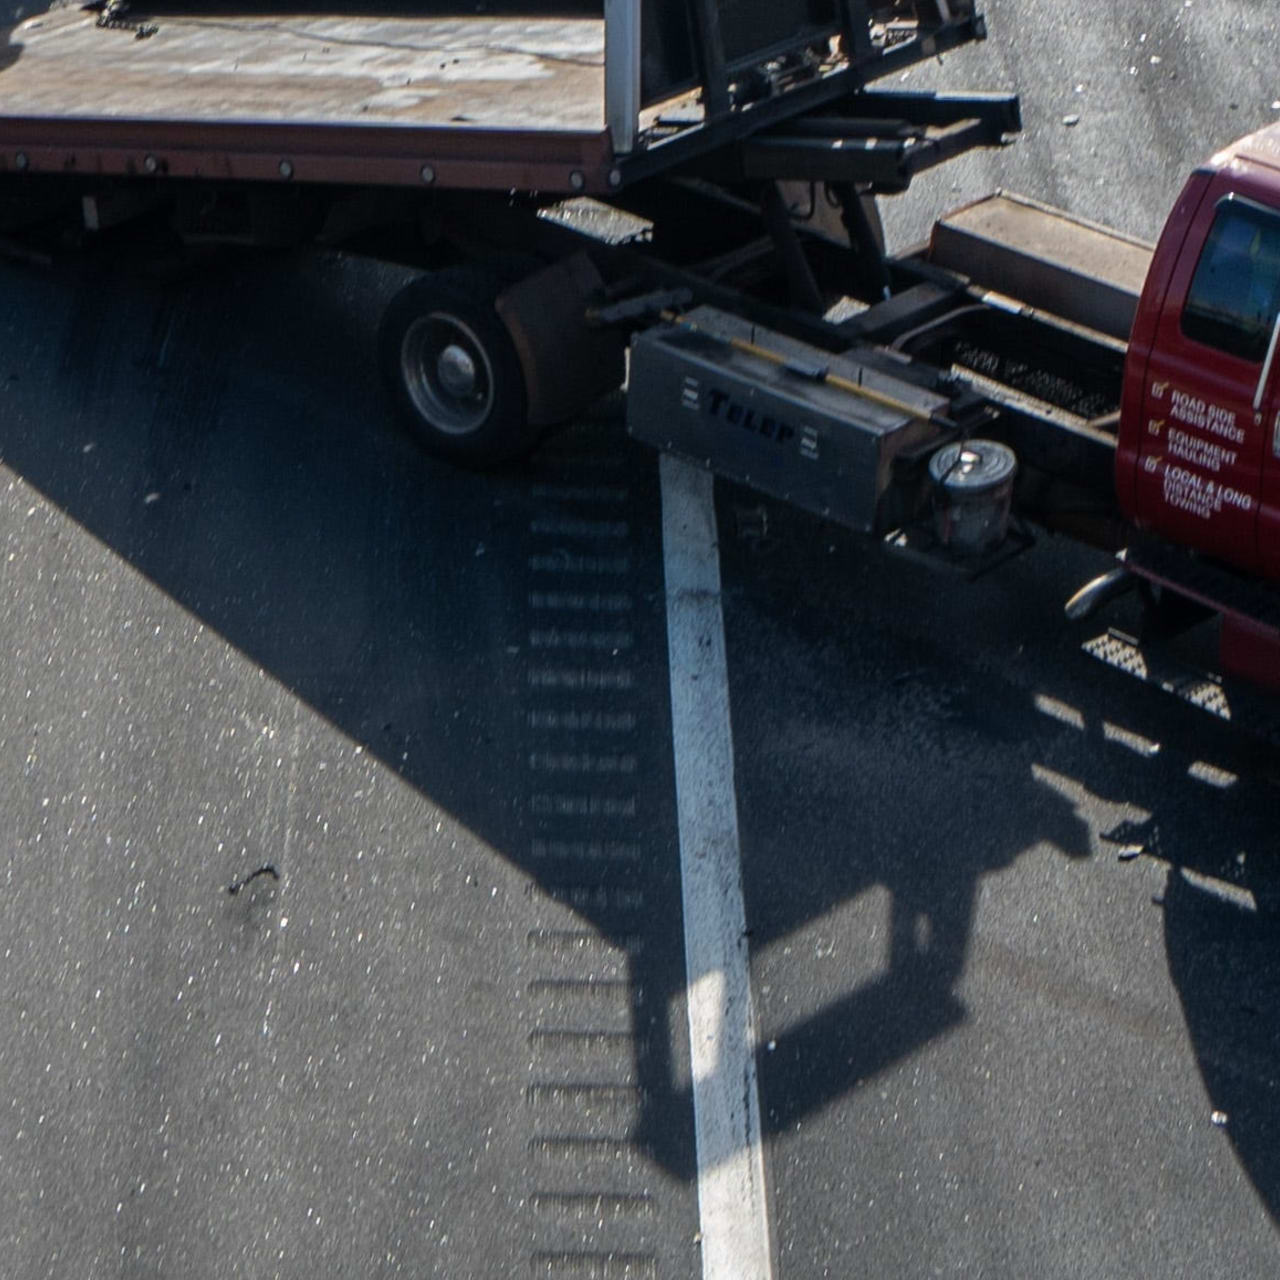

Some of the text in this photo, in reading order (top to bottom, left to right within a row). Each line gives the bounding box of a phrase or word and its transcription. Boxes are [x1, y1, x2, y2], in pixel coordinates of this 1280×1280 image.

[1170, 404, 1246, 444] ASSISTANCE
[1171, 390, 1236, 425] ROAD SIDE
[1168, 427, 1238, 465] EQUIPMENT
[1168, 442, 1220, 472] HAULING
[1164, 464, 1203, 490] LOCAL
[1216, 484, 1252, 510] LONG
